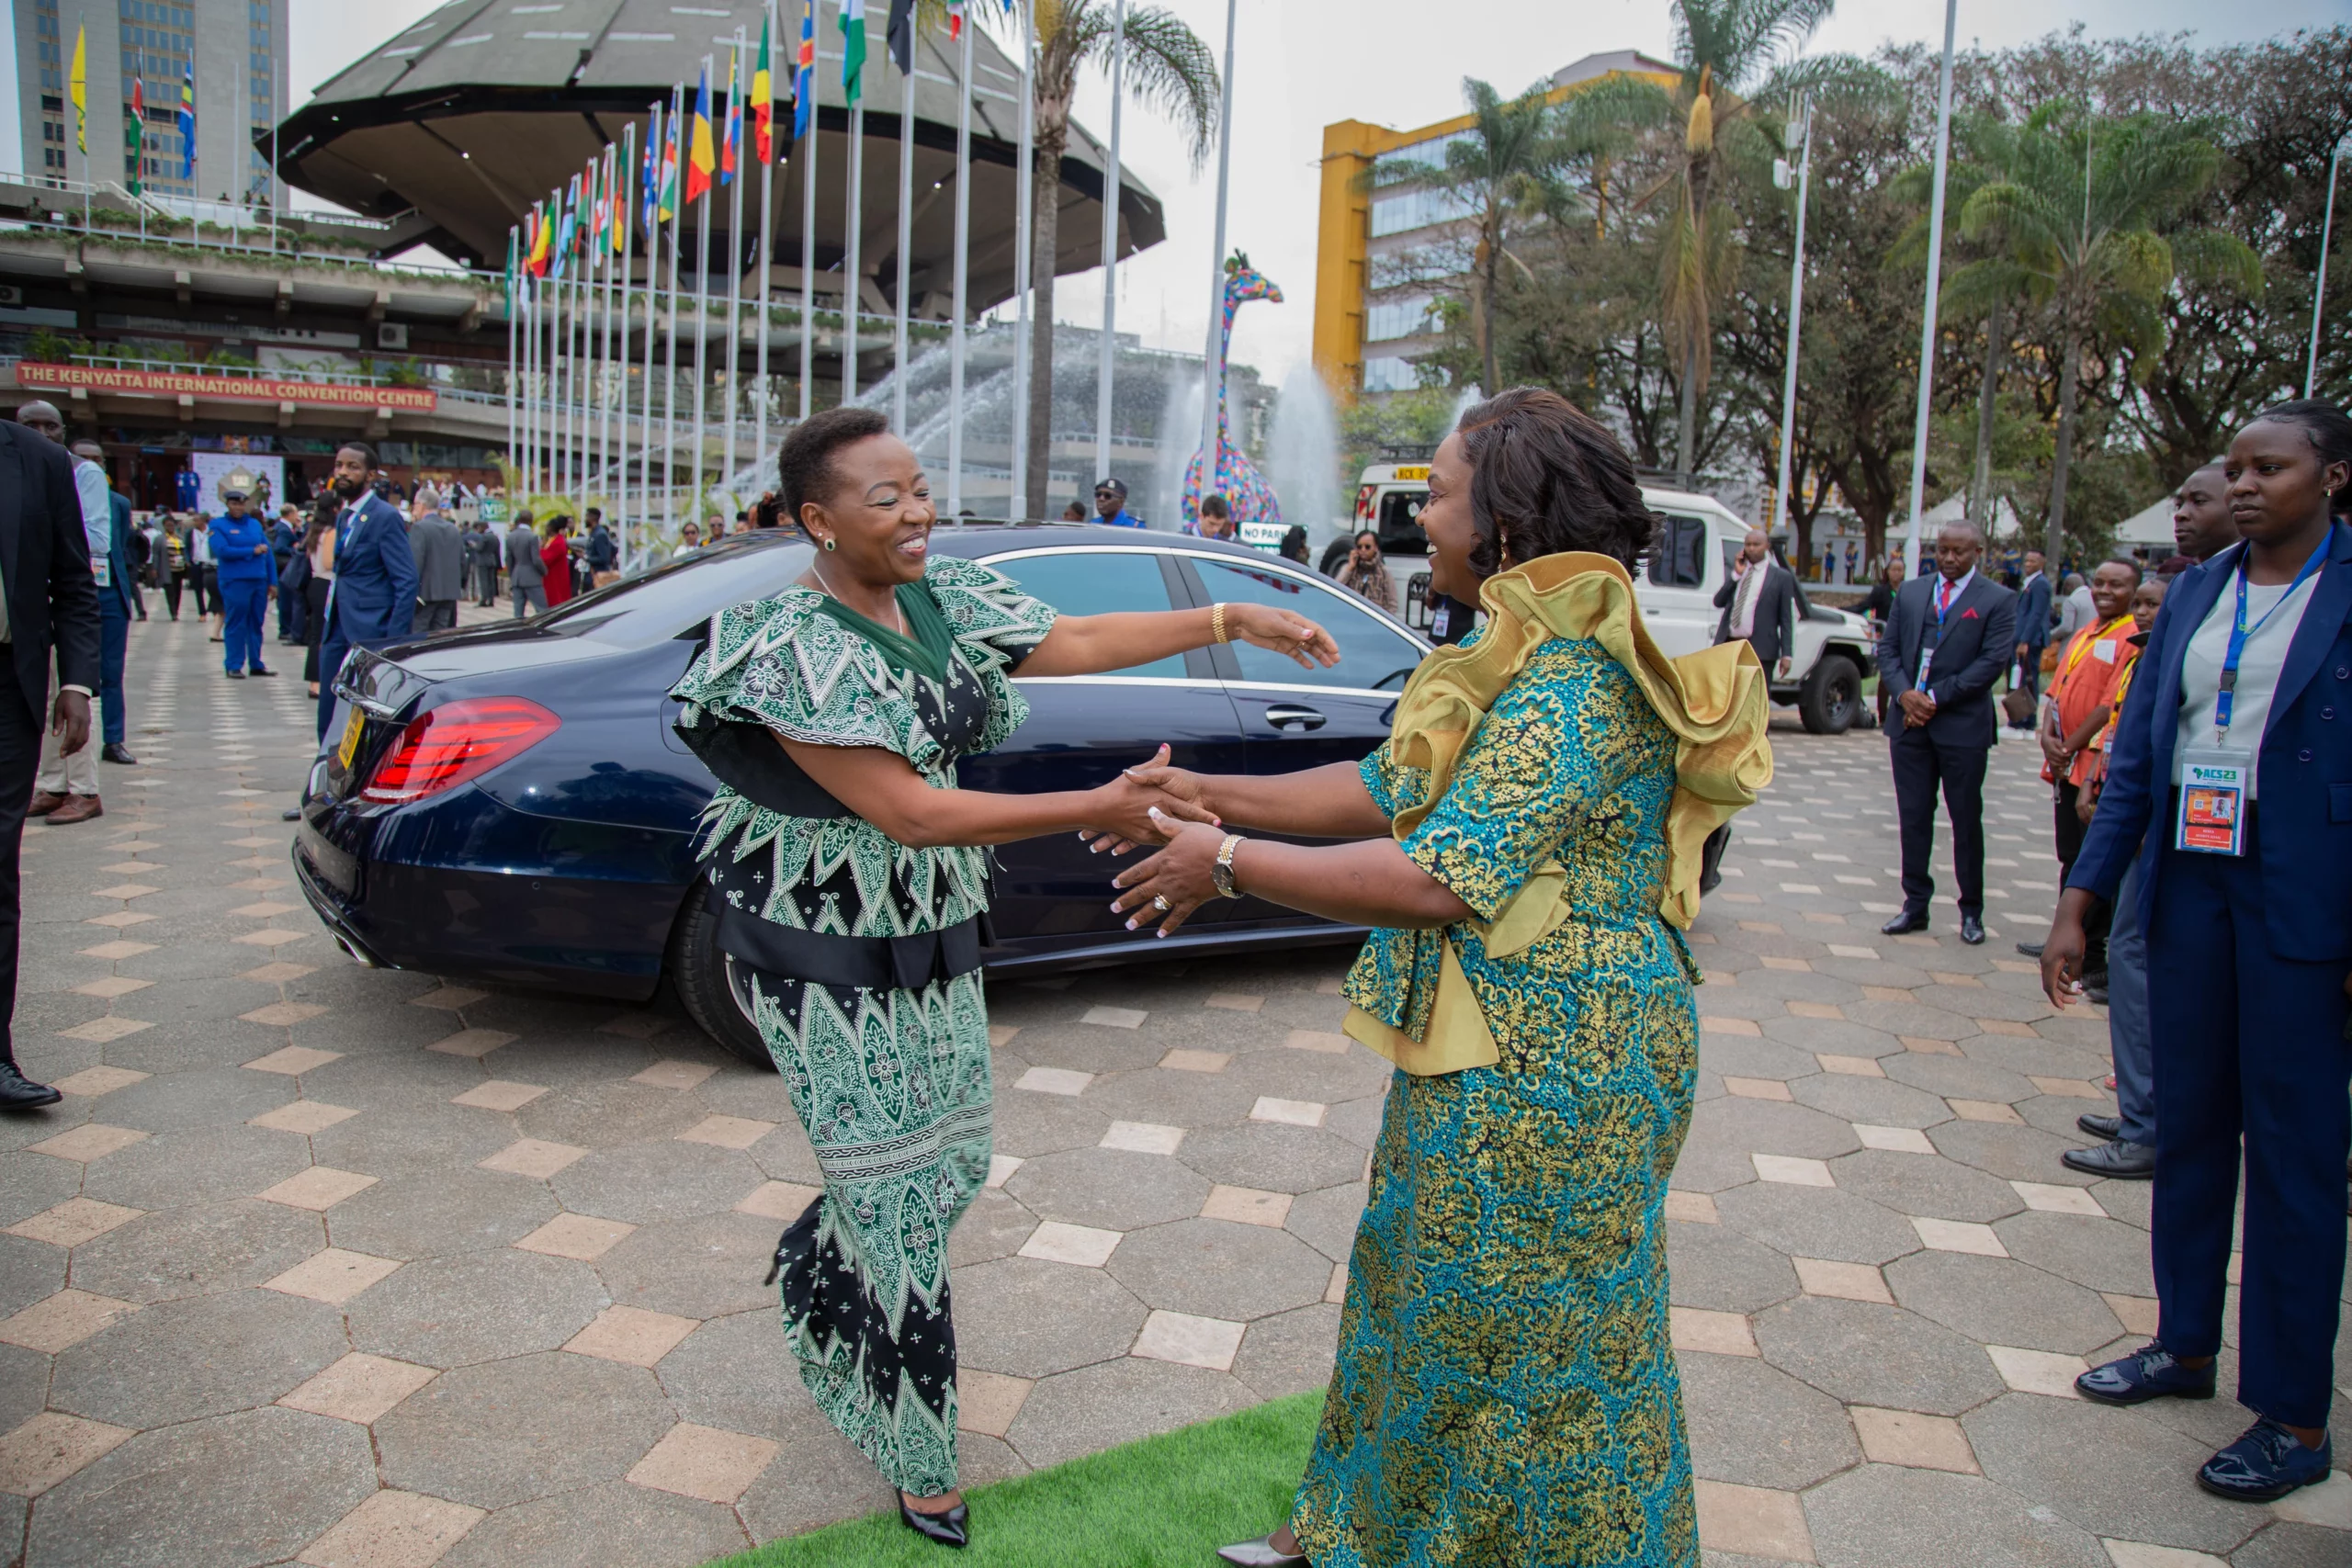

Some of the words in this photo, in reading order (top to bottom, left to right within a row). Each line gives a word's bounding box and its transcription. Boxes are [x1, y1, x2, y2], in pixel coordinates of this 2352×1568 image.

[21, 367, 55, 382] THE
[59, 368, 144, 389] KENYATTA
[147, 376, 274, 398] INTERNATIONAL
[276, 384, 374, 404] CONVENTION
[377, 391, 434, 408] CENTRE
[484, 502, 508, 515] VIP
[1244, 528, 1259, 538] NO
[2203, 768, 2237, 780] ACS23
